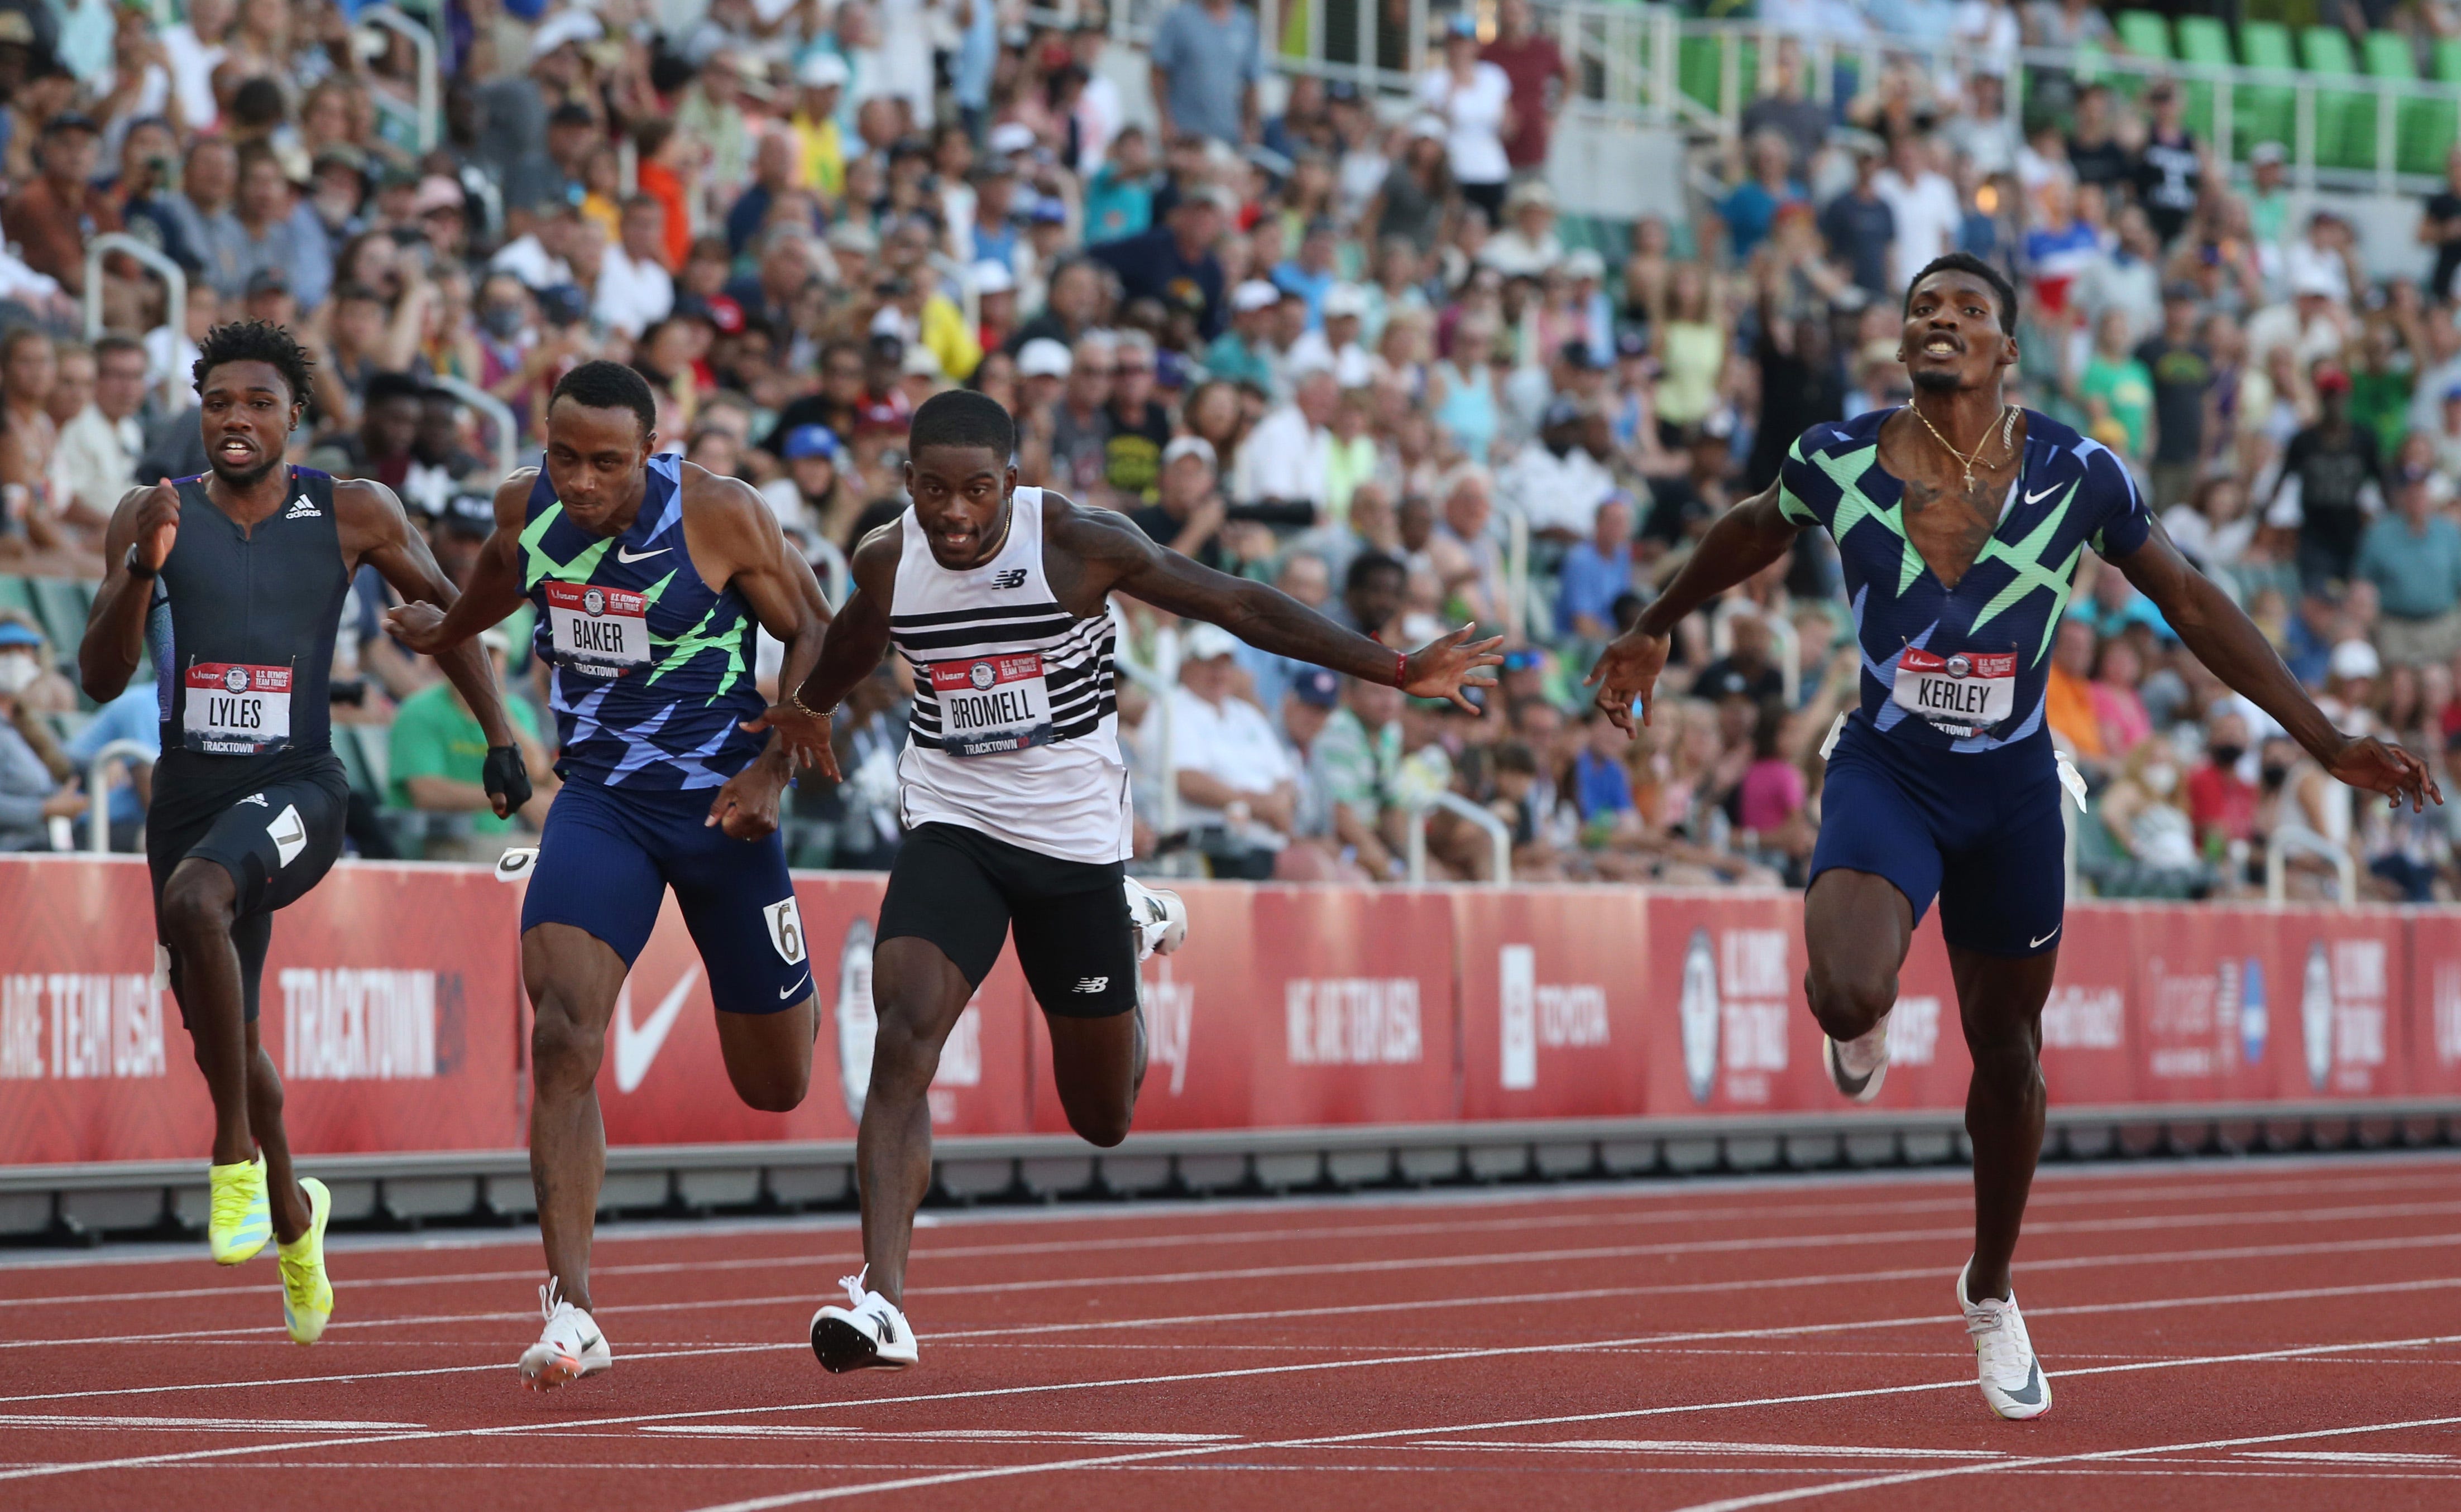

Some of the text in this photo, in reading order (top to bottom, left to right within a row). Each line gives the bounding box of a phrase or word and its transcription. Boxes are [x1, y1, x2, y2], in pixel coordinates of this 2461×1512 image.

[285, 508, 322, 519] adidas
[573, 618, 624, 652] BAKER
[256, 678, 270, 686] TEAM
[1918, 678, 1991, 713] KERLEY
[209, 697, 261, 729] LYLES
[950, 689, 1035, 729] BROMELL
[276, 814, 303, 846] 7
[778, 903, 798, 961] 6
